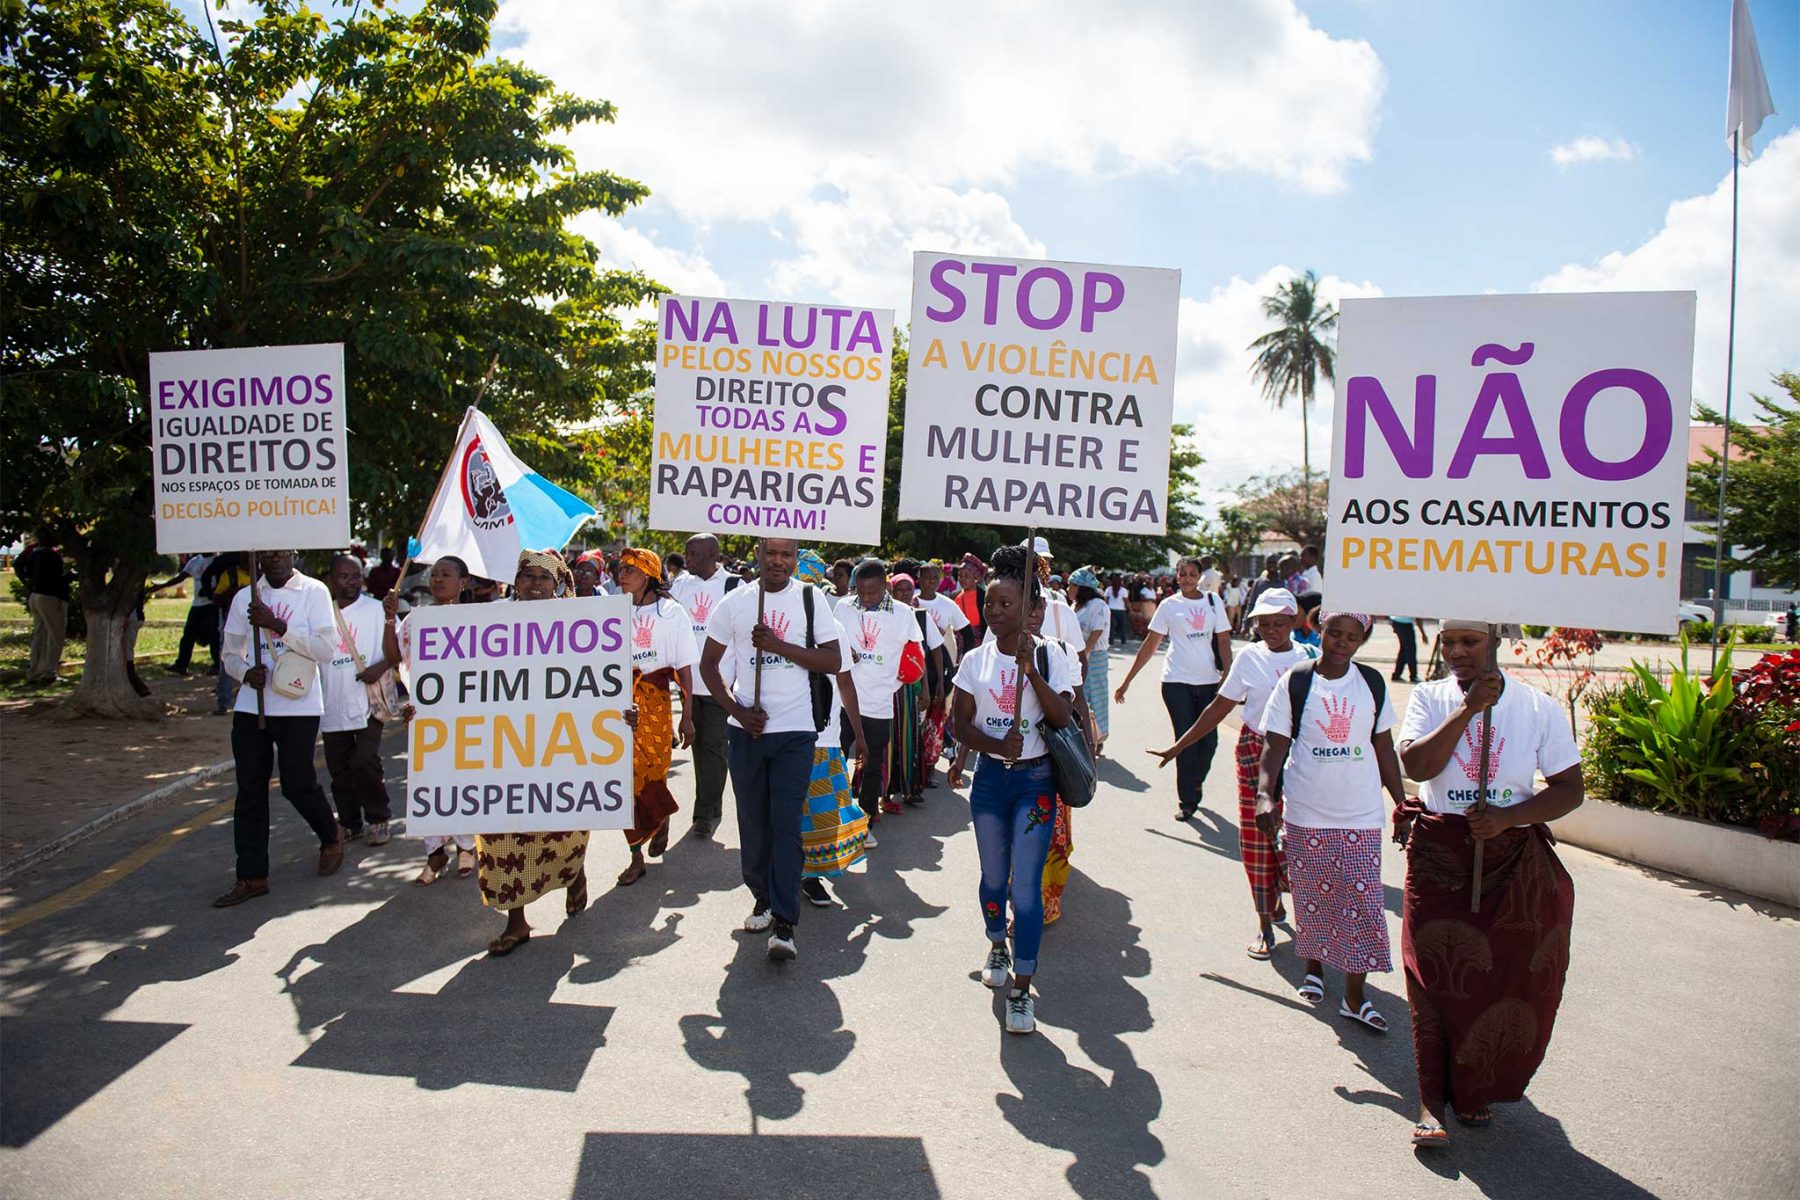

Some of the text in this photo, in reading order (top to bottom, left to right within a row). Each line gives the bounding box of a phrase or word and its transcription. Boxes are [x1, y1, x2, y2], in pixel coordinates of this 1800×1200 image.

[926, 260, 1124, 332] STOP
[665, 299, 882, 353] NA LUTA
[663, 344, 883, 381] PELOS NOSSOS
[922, 339, 1157, 384] A VIOLÊNCIA
[159, 374, 332, 409] EXIGIMOS
[696, 377, 847, 436] DIREITOS
[975, 384, 1142, 427] CONTRA
[1344, 342, 1673, 481] NÃO
[159, 412, 332, 437] IGUALDADE DE
[696, 405, 785, 432] TODAS
[161, 438, 336, 475] DIREITOS
[659, 431, 876, 473] MULHERES E
[927, 425, 1139, 472] MULHER E
[162, 477, 336, 494] NOS ESPAÇOS DE TOMADA DE
[657, 464, 875, 508] RAPARIGAS
[945, 475, 1158, 523] RAPARIGA
[161, 496, 335, 520] DECISÃO POLÍTICA!
[707, 503, 827, 531] CONTAM!
[1342, 499, 1670, 529] AOS CASAMENTOS
[1343, 537, 1666, 578] PREMATURAS!
[419, 618, 622, 660] EXIGIMOS
[750, 655, 783, 666] CEGA!
[416, 664, 622, 705] O FIM DAS
[412, 709, 625, 772] PENAS
[1312, 746, 1350, 757] CHEGA!
[413, 780, 622, 817] SUSPENSAS
